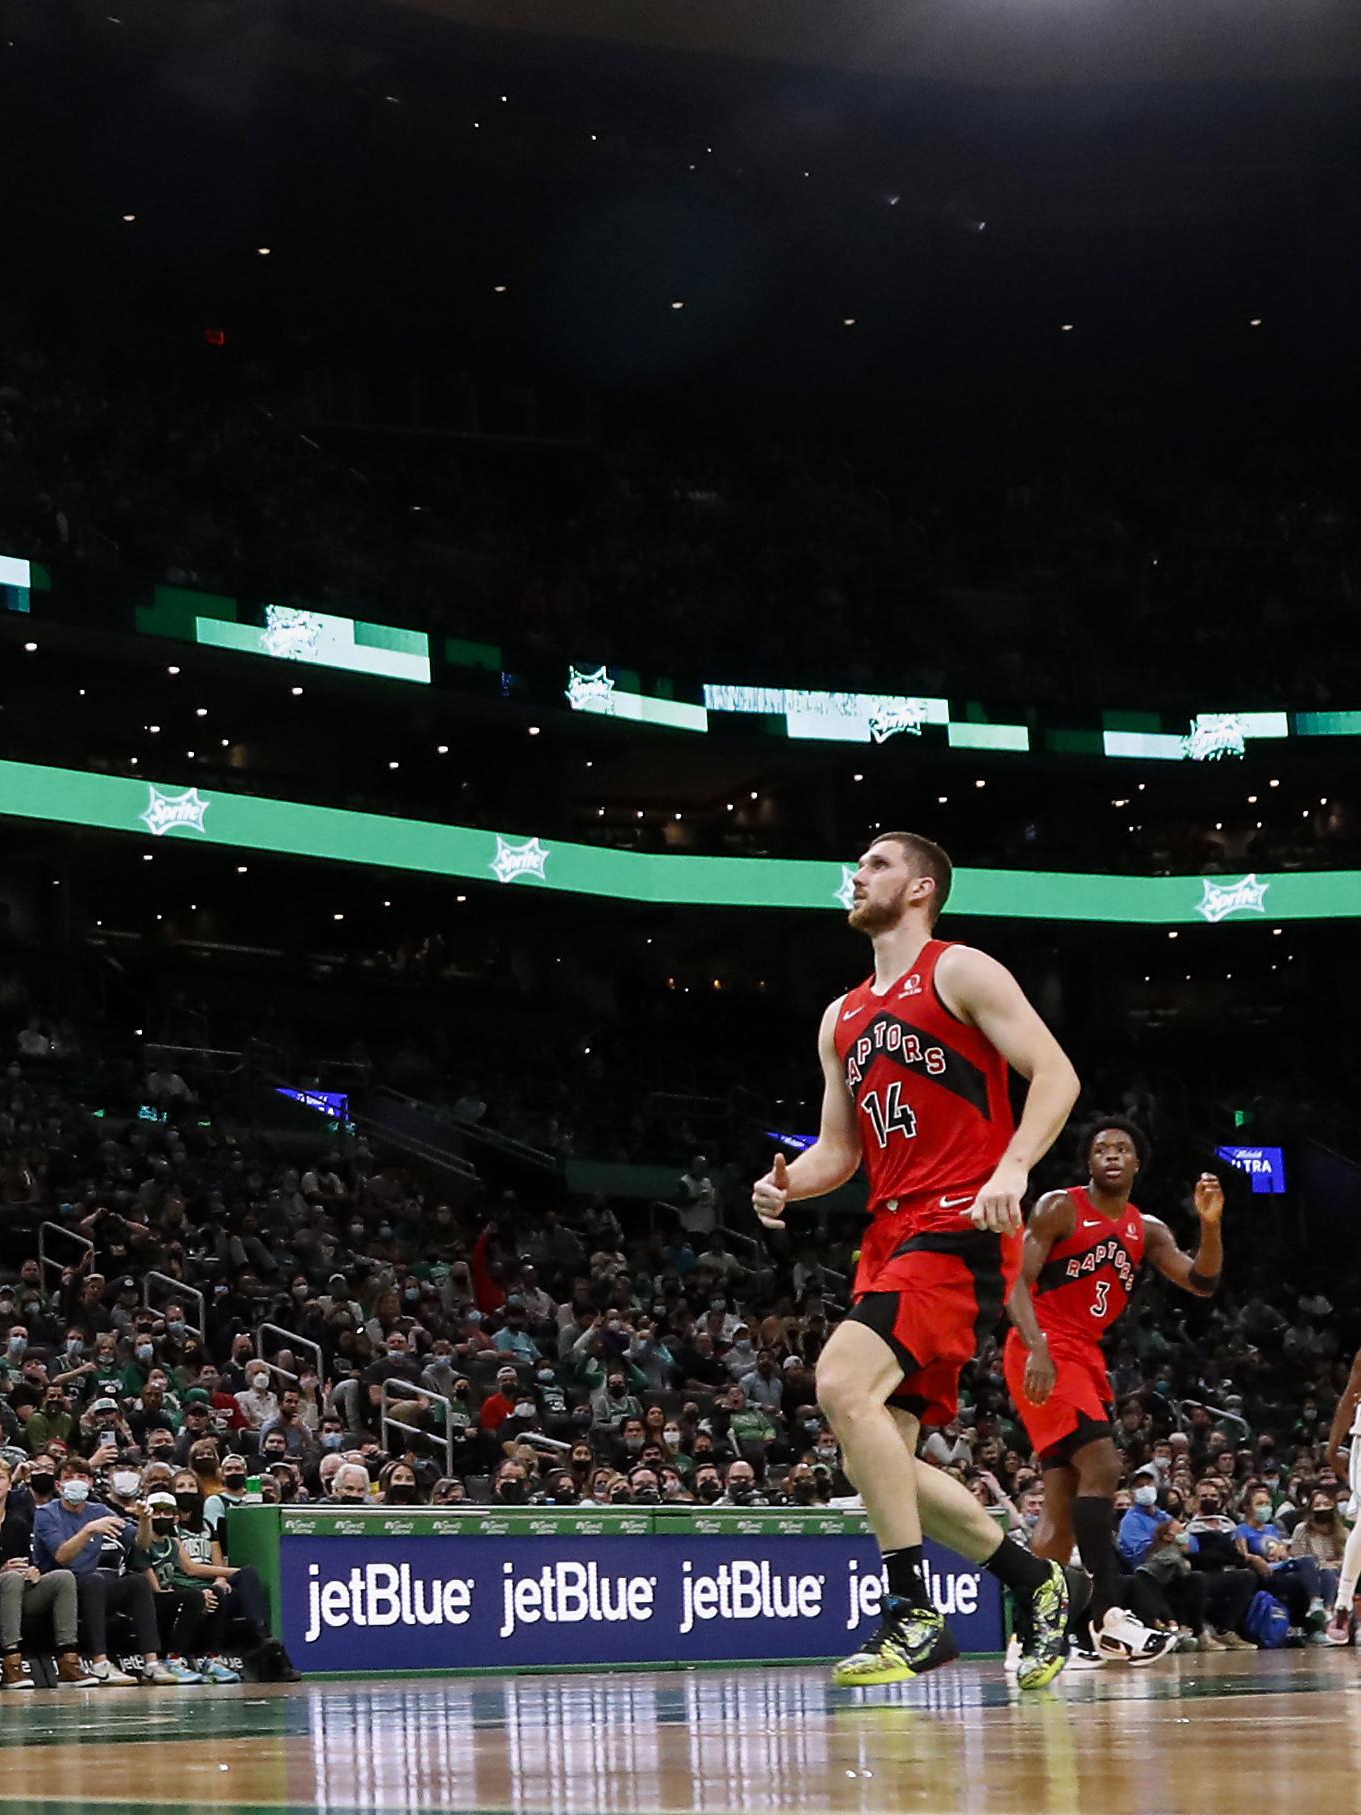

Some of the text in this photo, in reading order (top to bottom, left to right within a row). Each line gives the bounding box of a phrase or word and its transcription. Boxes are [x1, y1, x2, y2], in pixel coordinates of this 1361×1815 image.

[149, 799, 201, 824] Sprite
[847, 1021, 946, 1092] APTORS
[861, 1081, 917, 1148] 14
[1089, 1281, 1111, 1317] 3
[305, 1563, 472, 1643] jetBlue
[500, 1562, 654, 1638] jetBlue
[680, 1560, 823, 1634] jetBlue
